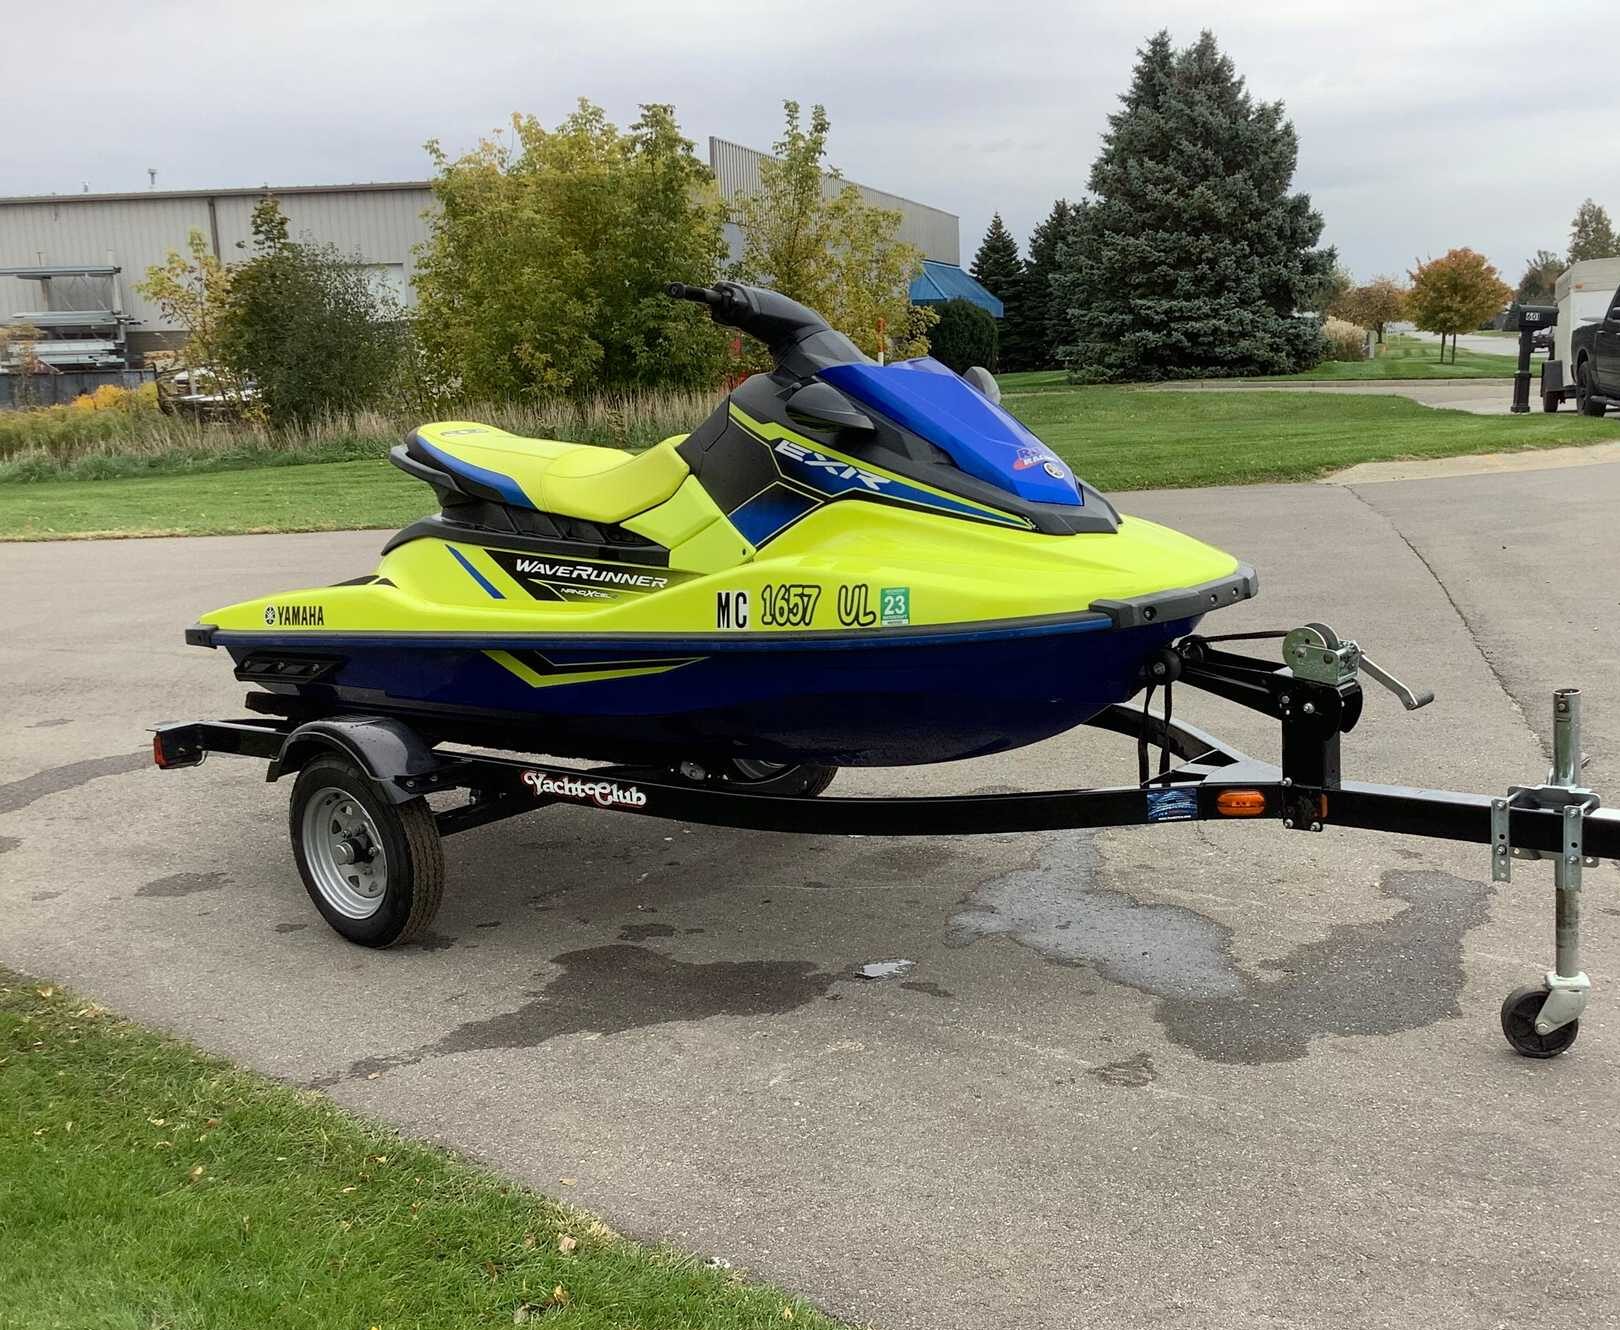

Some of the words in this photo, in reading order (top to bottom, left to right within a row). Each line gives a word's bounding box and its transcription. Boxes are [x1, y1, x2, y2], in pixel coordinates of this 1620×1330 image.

[277, 606, 325, 626] YAMAHA
[717, 592, 747, 628] MC
[761, 584, 821, 627] 1657
[837, 583, 877, 627] UL
[884, 595, 906, 616] 23
